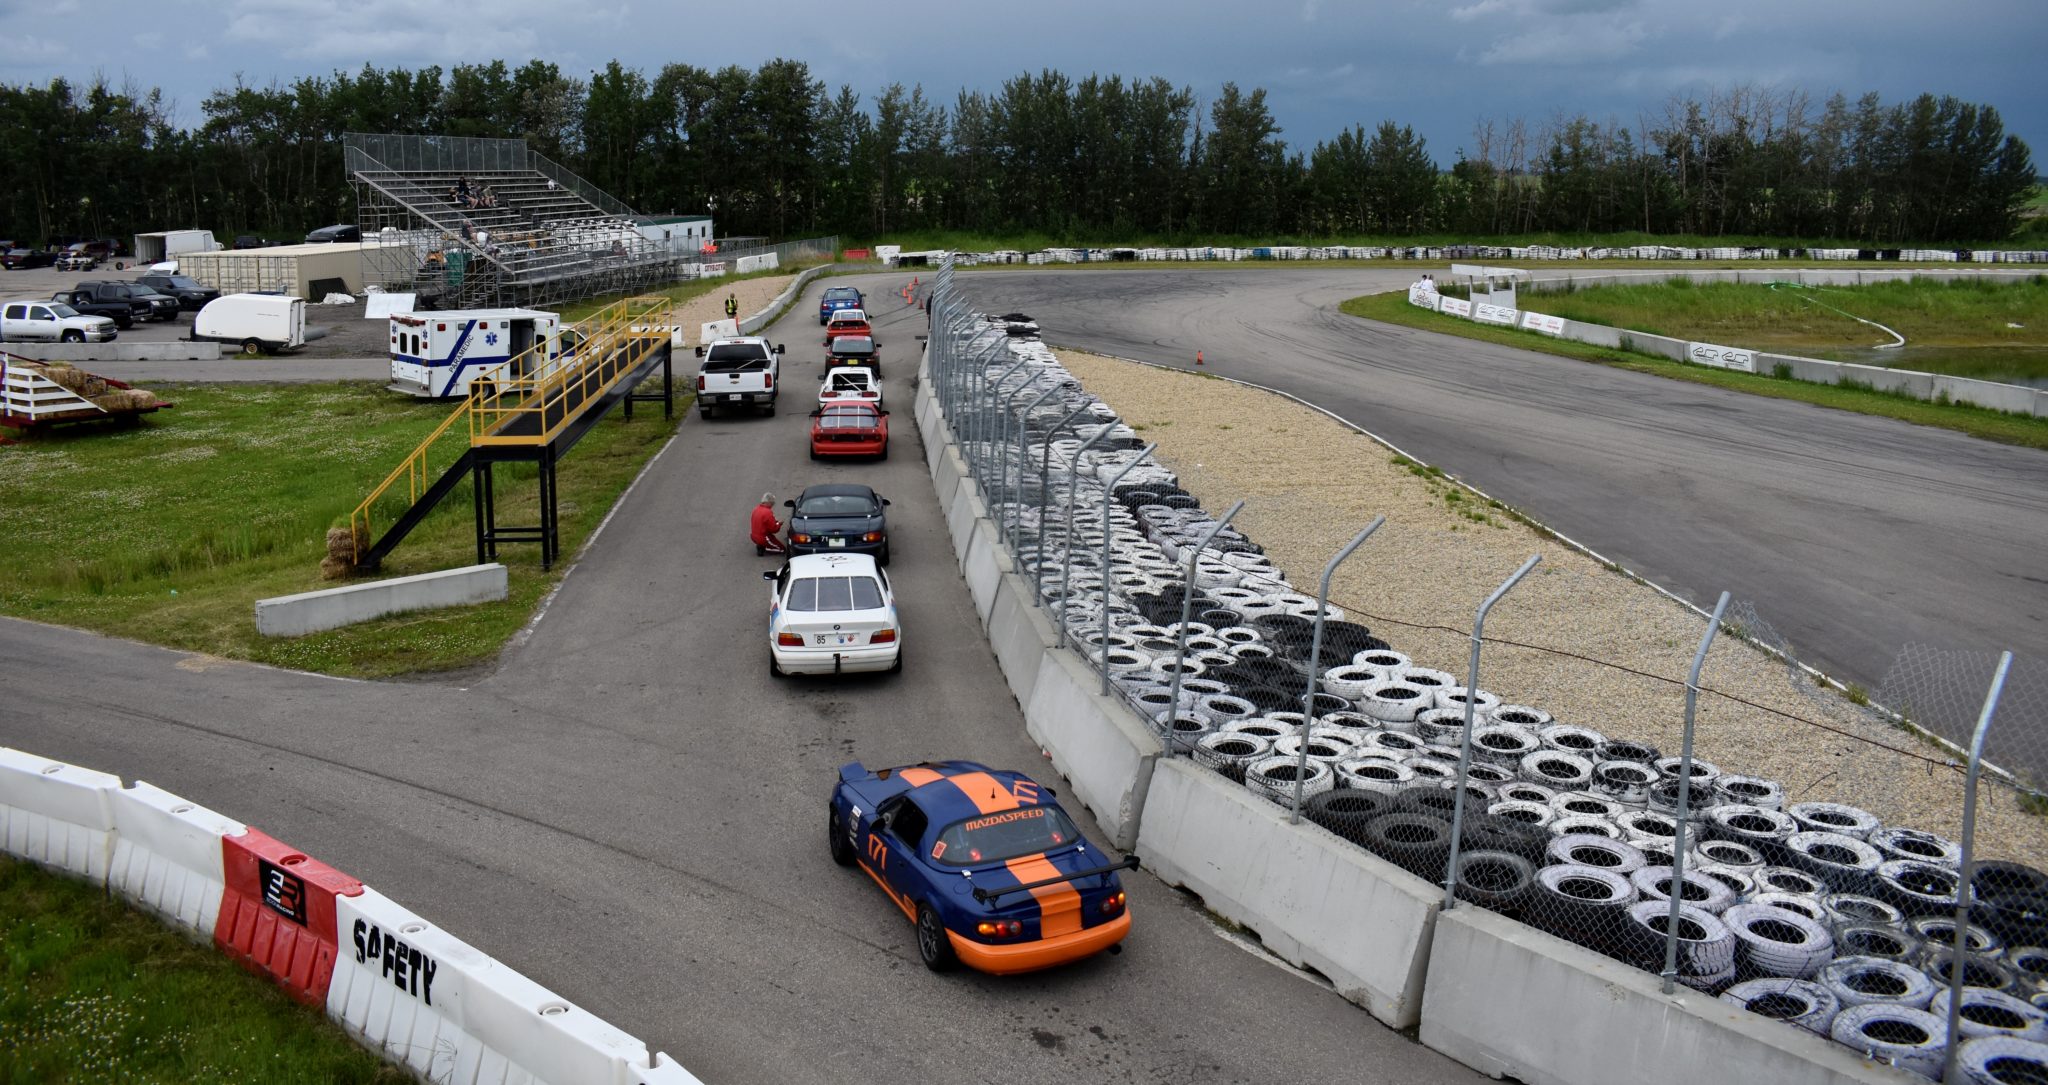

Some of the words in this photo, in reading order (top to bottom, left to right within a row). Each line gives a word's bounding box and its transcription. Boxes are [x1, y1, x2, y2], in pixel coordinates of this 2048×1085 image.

[448, 334, 474, 373] PARAMEDIC
[816, 635, 826, 645] 85
[965, 808, 1045, 832] MAZDASPEED
[868, 833, 888, 870] 171
[353, 917, 437, 1006] SAFETY
